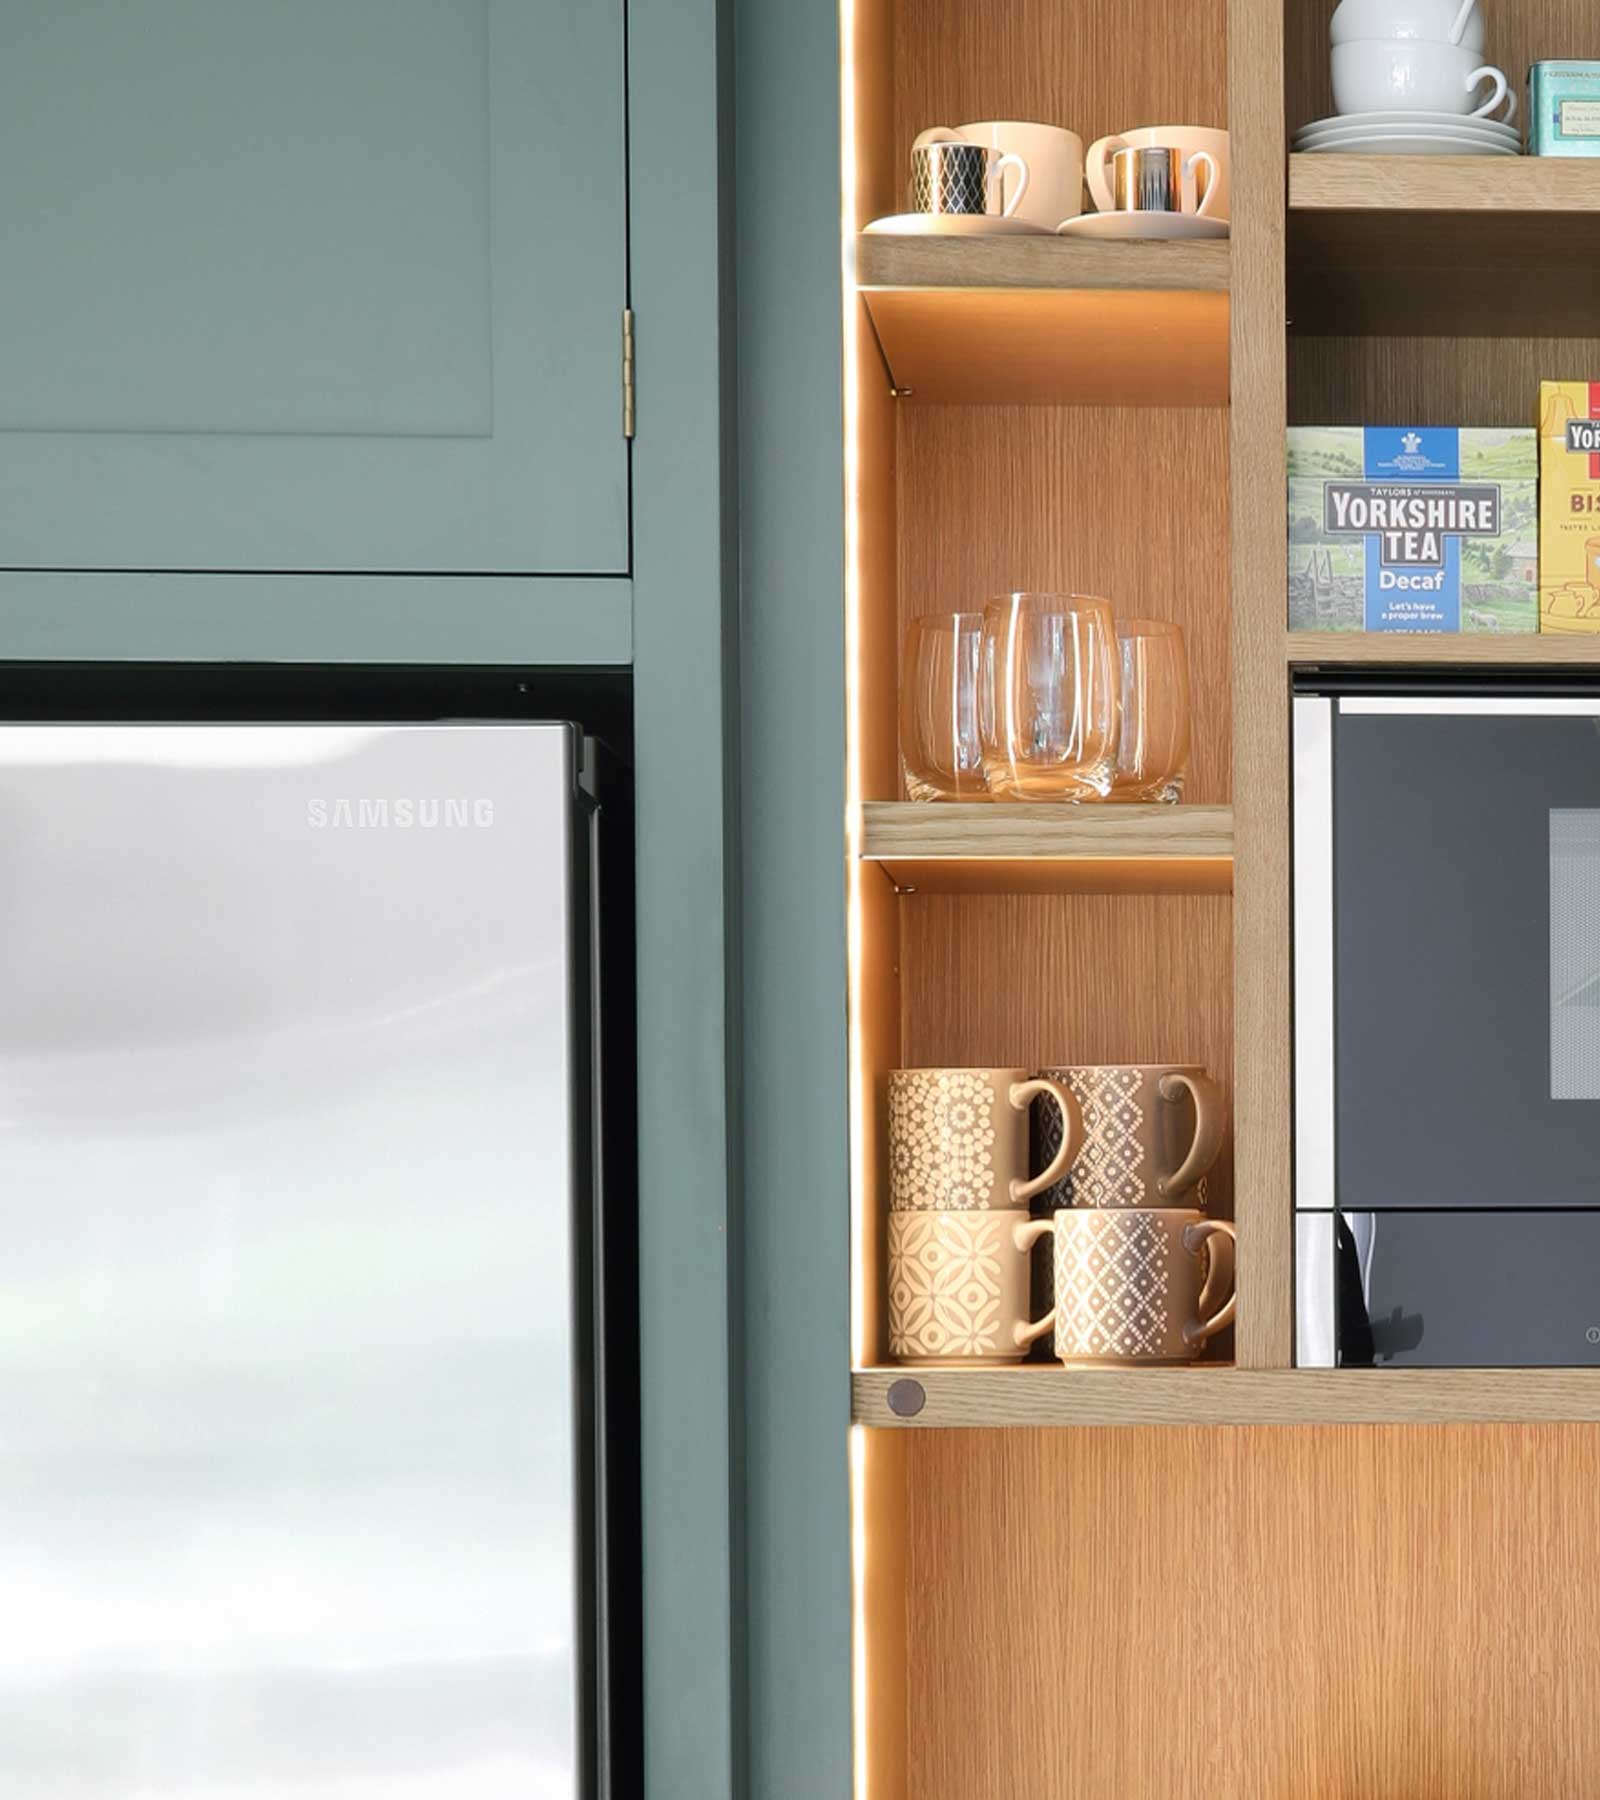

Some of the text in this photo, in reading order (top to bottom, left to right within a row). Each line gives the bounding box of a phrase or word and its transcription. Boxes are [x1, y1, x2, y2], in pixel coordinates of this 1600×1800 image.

[1332, 492, 1492, 529] YORKSHIRE
[1386, 531, 1439, 561] TEA
[1379, 571, 1445, 590] Decaf
[1388, 612, 1419, 621] proper
[1420, 612, 1444, 620] brew
[1389, 601, 1436, 611] Let's have
[306, 798, 495, 828] SAMSUNG
